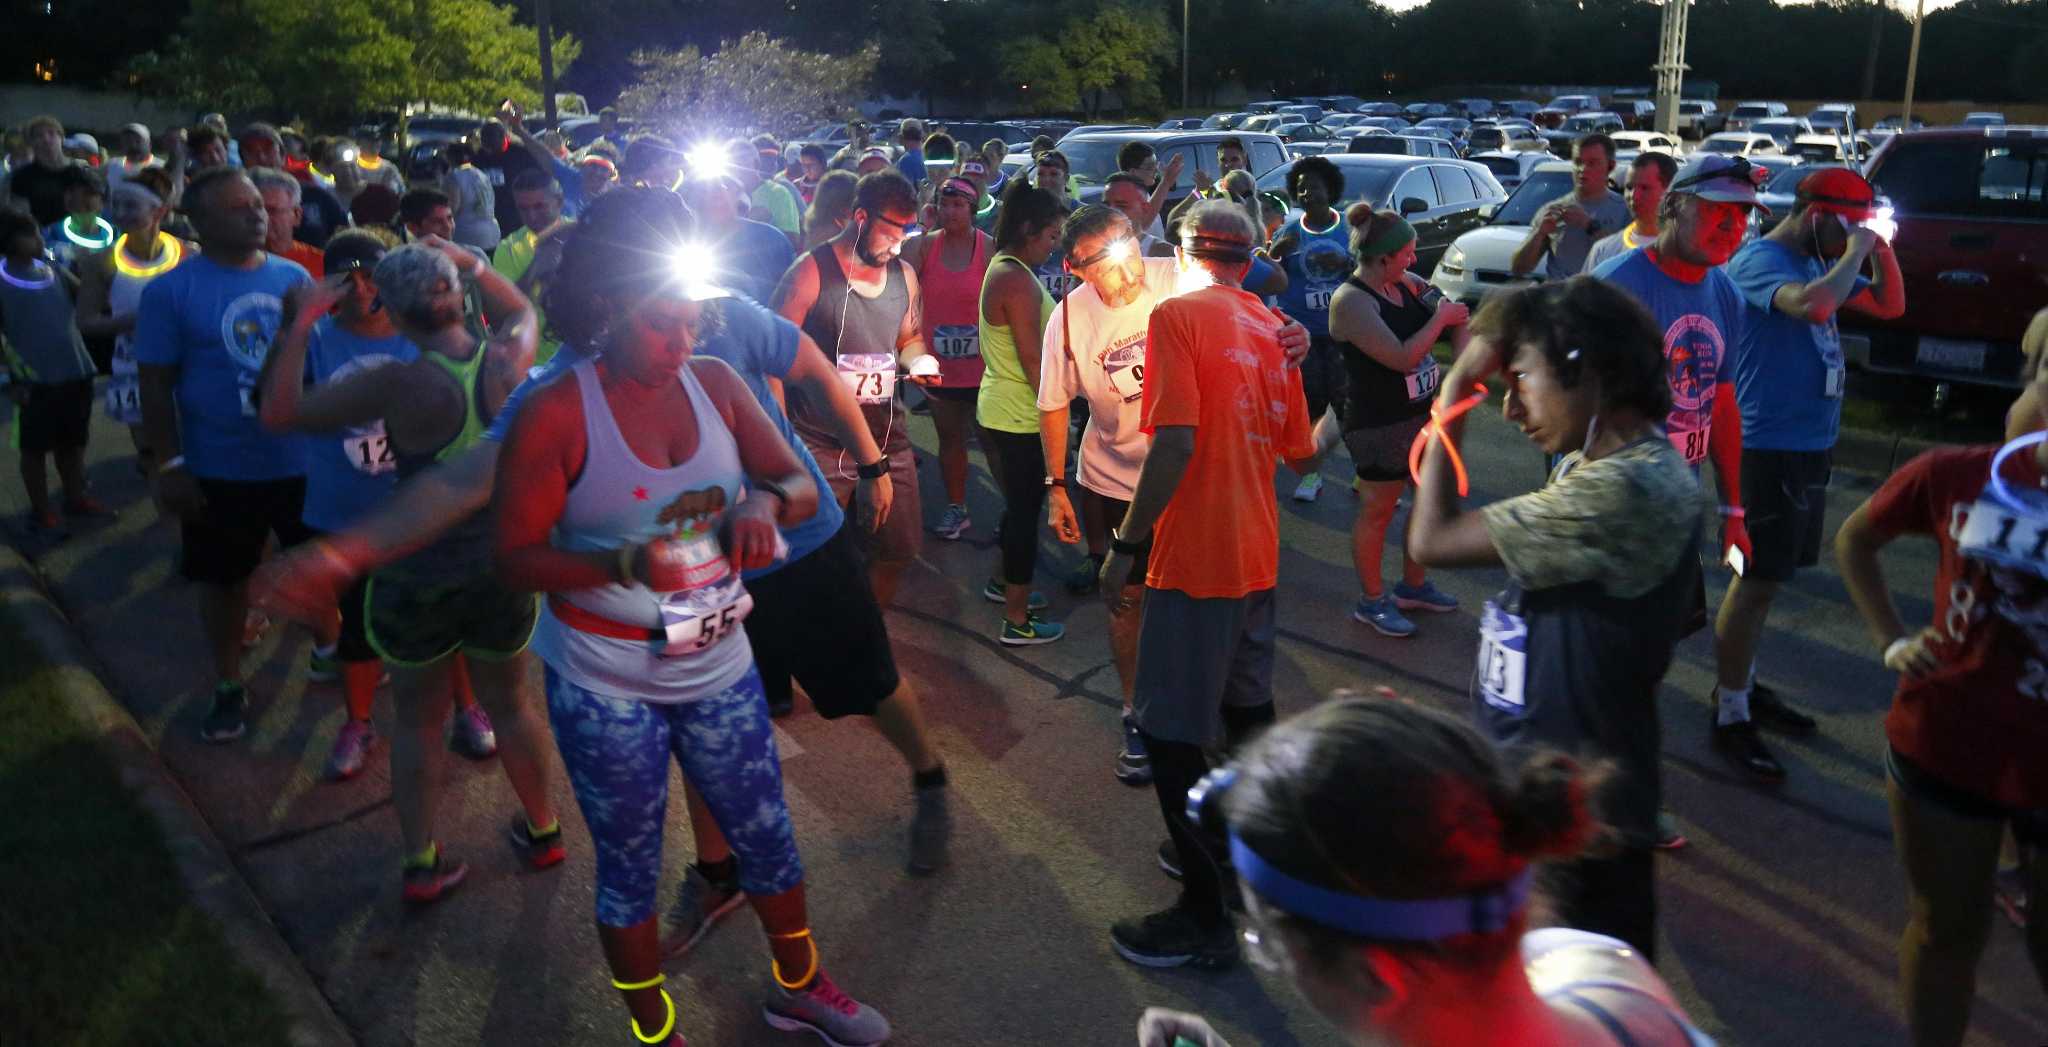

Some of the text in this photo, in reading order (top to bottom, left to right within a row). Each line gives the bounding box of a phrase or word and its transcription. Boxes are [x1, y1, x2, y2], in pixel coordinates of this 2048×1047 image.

[942, 337, 973, 355] 107
[855, 372, 883, 396] 73
[1415, 367, 1437, 395] 127
[1685, 429, 1706, 460] 81
[695, 602, 738, 649] 55
